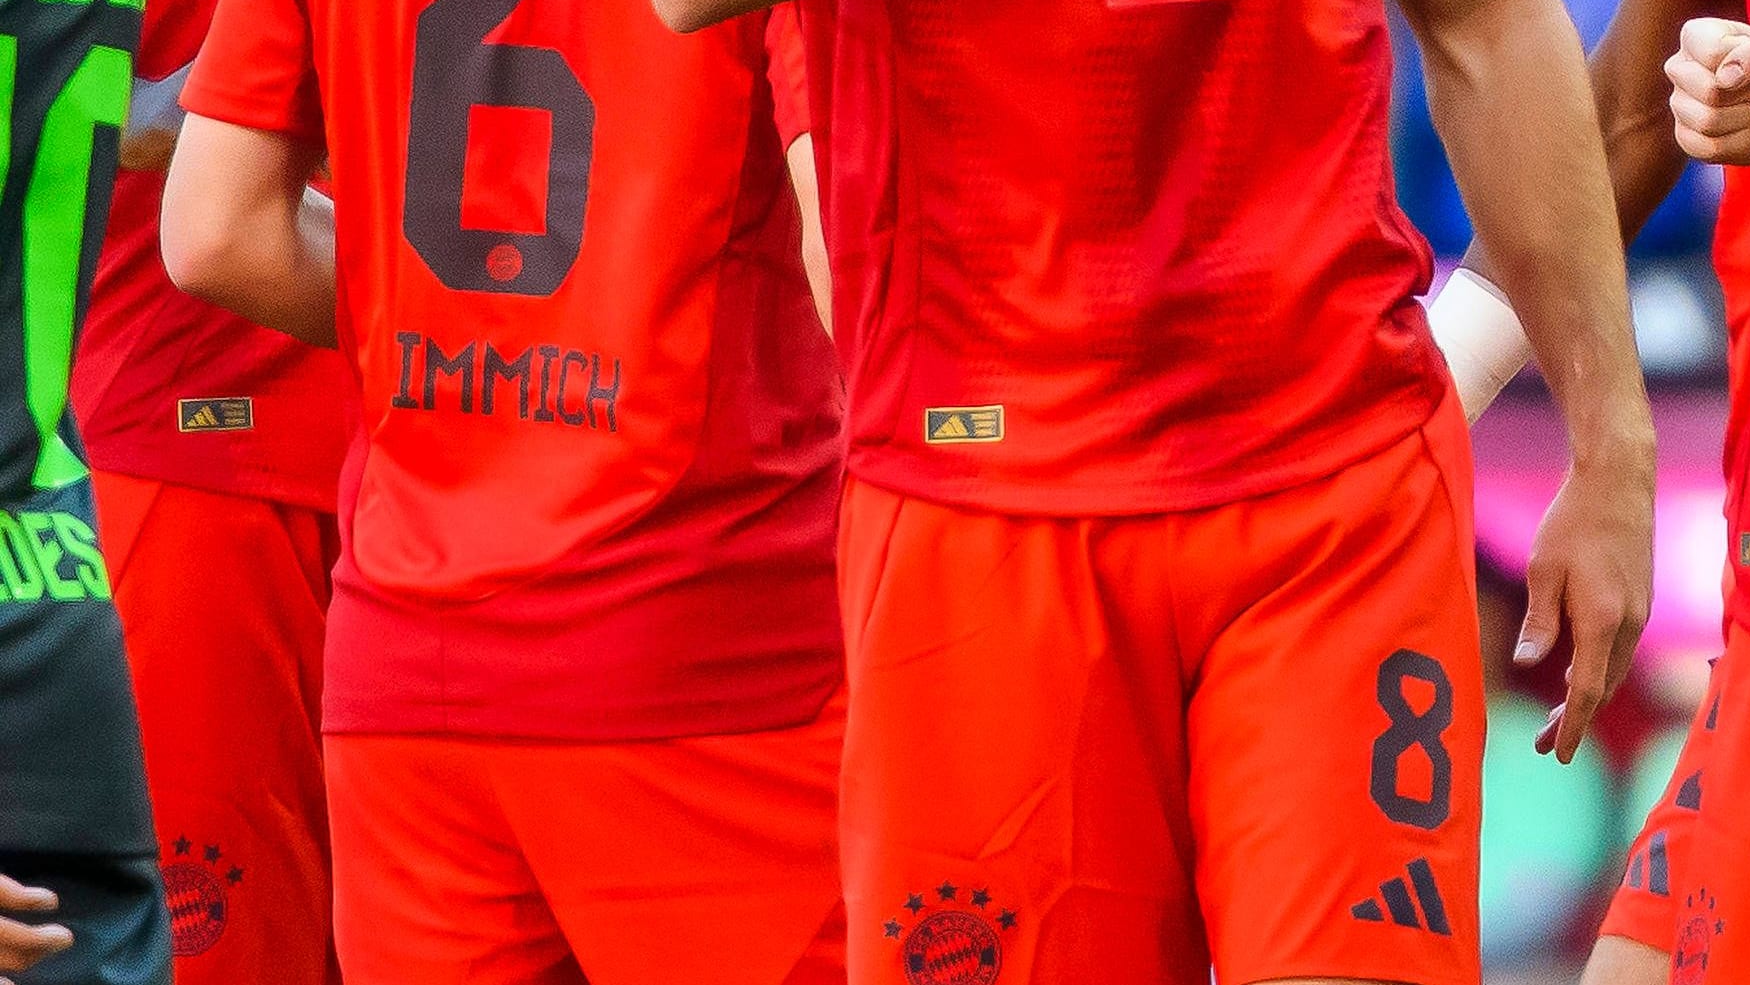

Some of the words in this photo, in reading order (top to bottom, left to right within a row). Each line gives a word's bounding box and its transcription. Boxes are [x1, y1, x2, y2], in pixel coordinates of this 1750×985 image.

[391, 331, 621, 433] IMMICH
[0, 510, 113, 603] DES
[1370, 648, 1454, 830] 8
